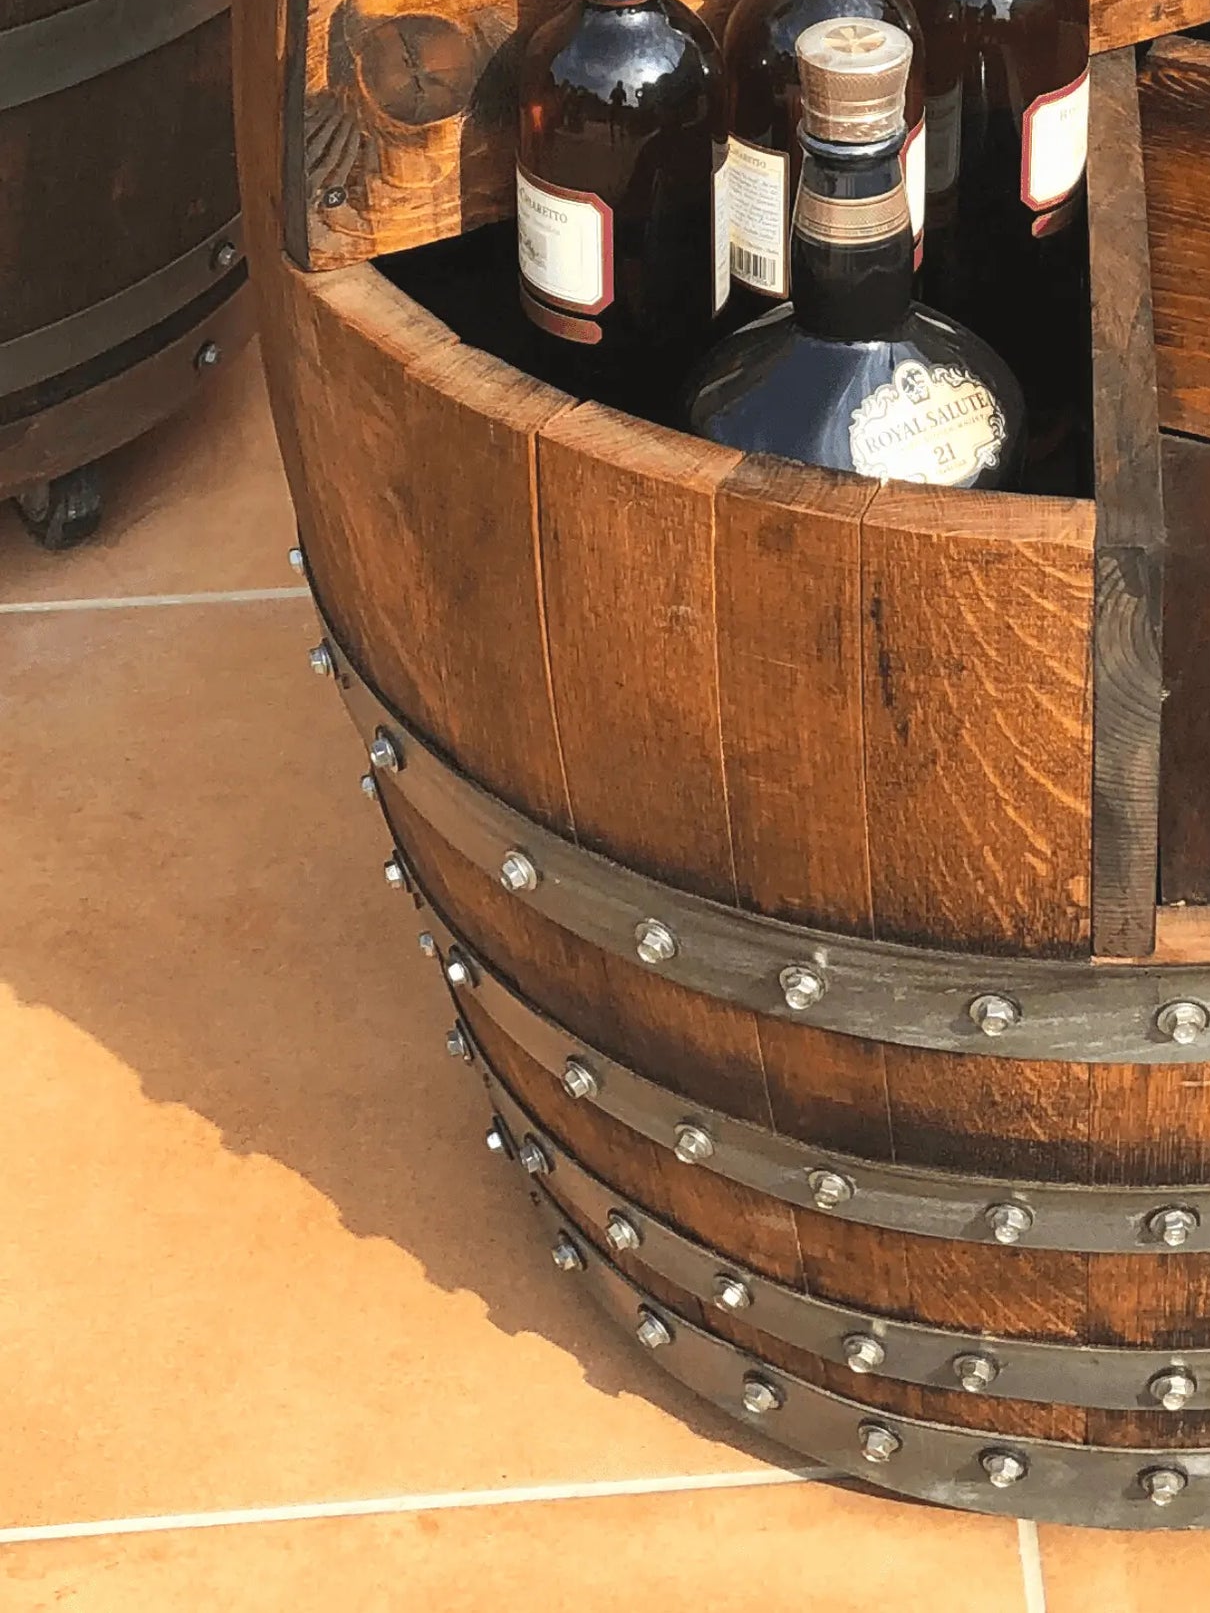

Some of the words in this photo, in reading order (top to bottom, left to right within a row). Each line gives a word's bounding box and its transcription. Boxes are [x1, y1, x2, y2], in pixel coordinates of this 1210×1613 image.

[864, 417, 927, 454] ROYAL
[926, 391, 990, 429] SALUTE
[933, 442, 957, 465] 21
